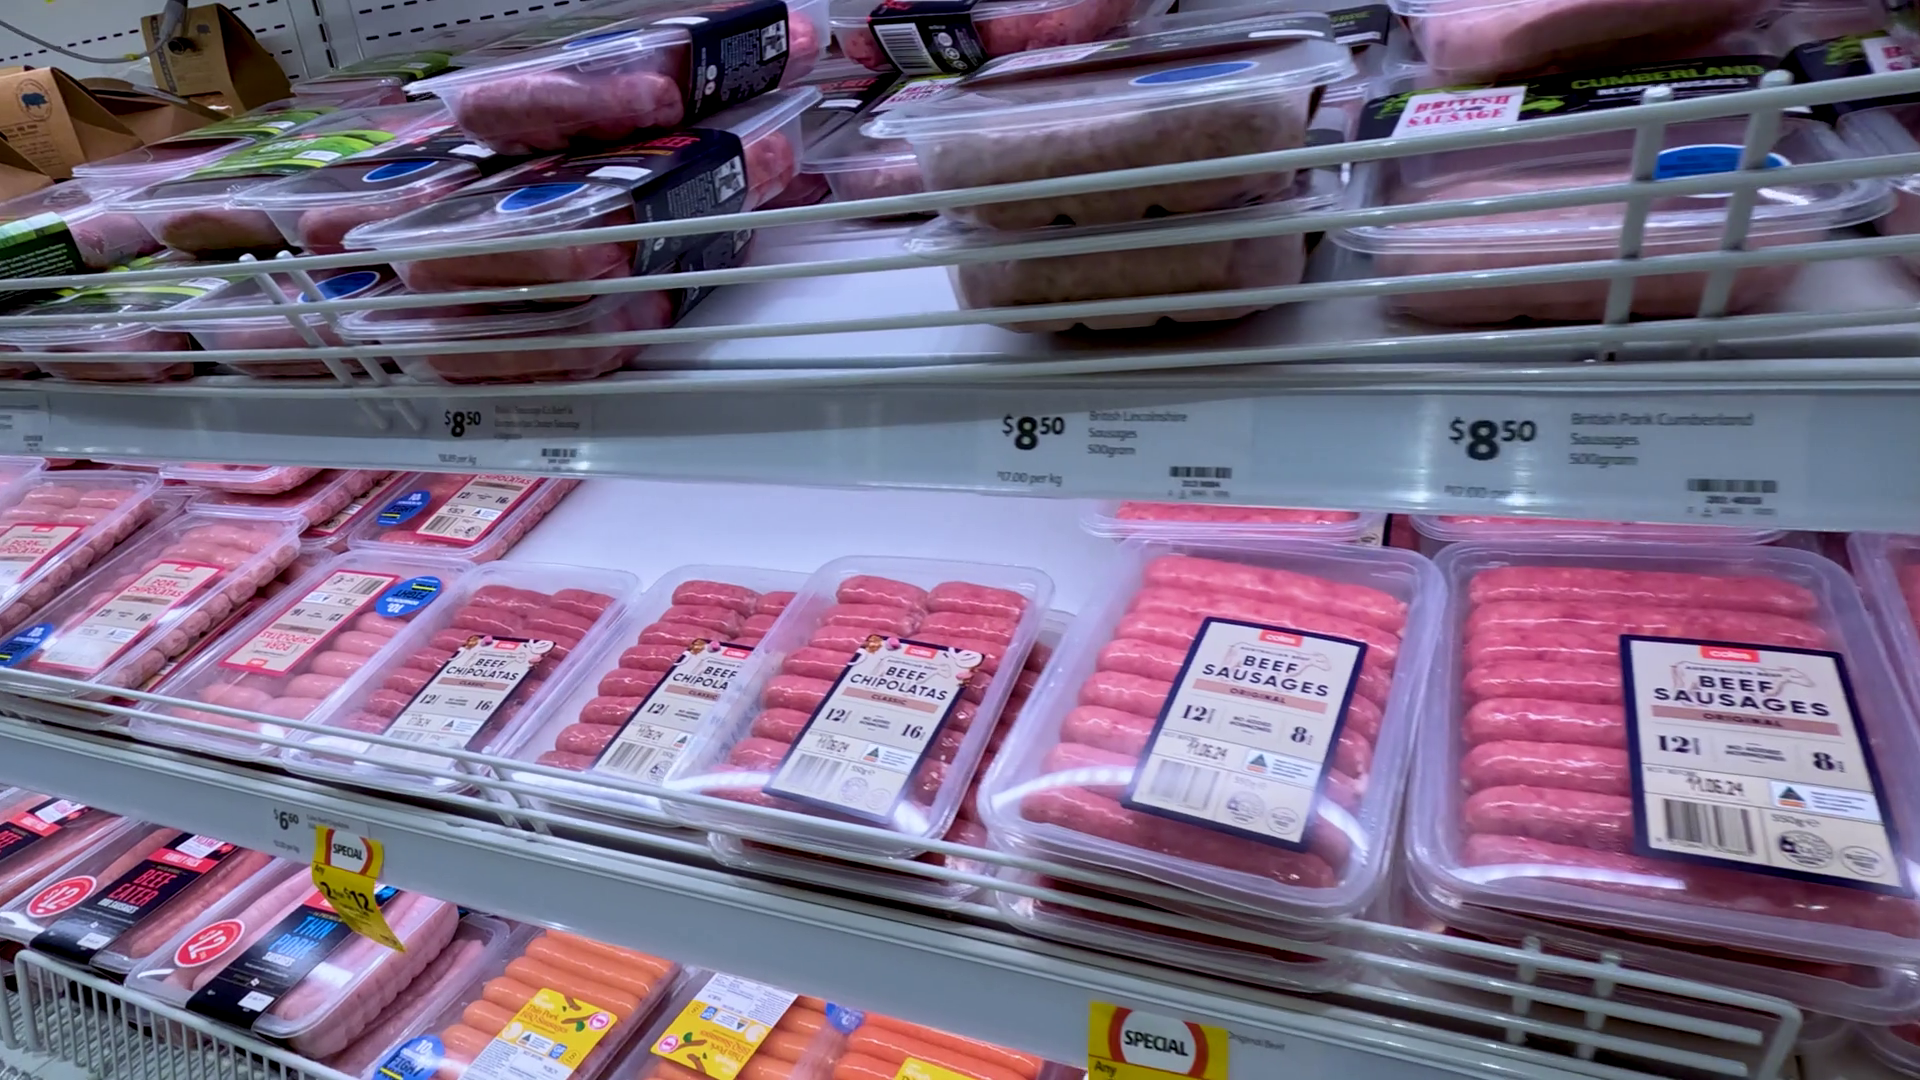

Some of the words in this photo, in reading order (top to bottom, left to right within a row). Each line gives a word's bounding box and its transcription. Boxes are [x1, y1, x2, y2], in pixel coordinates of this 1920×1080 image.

[1571, 65, 1764, 89] CUMBERLAND
[1414, 95, 1512, 114] BRITISH
[1406, 107, 1506, 128] SAUSAGE
[1088, 428, 1137, 441] Sausages
[1570, 432, 1640, 449] Sausages
[1049, 472, 1063, 487] kg
[475, 658, 507, 668] BEEF
[1242, 655, 1299, 674] BEEF
[446, 666, 519, 681] CHIPOLATAS
[703, 666, 738, 679] BEEF
[886, 666, 927, 681] BEEF
[1202, 663, 1329, 698] SAUSAGES
[850, 673, 948, 701] CHIPOLATAS
[1699, 675, 1773, 693] BEEF
[419, 694, 437, 704] 12
[475, 700, 493, 711] 16
[1230, 687, 1286, 704] ORIGINAL
[1654, 687, 1830, 717] SAUSAGES
[646, 703, 665, 714] 12
[825, 708, 846, 722] 12
[1181, 704, 1208, 722] 12
[1703, 713, 1783, 728] ORIGINAL
[901, 723, 923, 739] 16
[1290, 726, 1307, 743] 8
[1657, 735, 1690, 753] 12
[1813, 752, 1835, 771] 8
[332, 843, 363, 860] SPECIAL
[133, 869, 178, 888] BEEF
[315, 864, 326, 876] Any
[108, 883, 159, 906] EATER
[320, 881, 337, 900] 2
[293, 915, 339, 940] THIN
[268, 933, 319, 960] PORK
[1124, 1030, 1189, 1057] SPECIAL
[1094, 1060, 1116, 1077] Any
